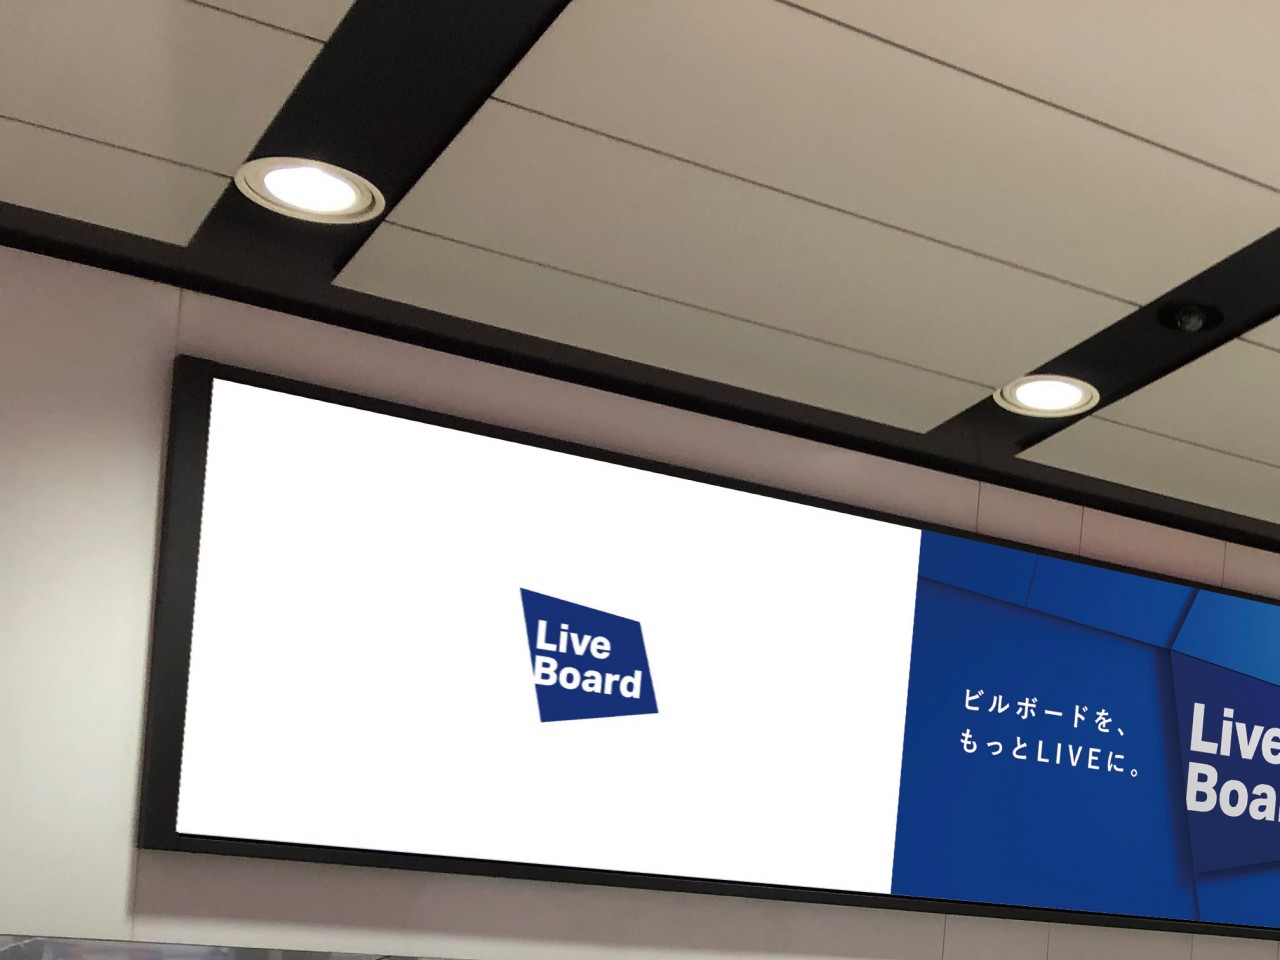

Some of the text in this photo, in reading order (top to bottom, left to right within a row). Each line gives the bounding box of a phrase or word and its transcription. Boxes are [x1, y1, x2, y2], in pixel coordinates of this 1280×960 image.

[536, 619, 611, 660] Live
[534, 655, 643, 700] Board
[963, 688, 1125, 737] ビルボードを、
[959, 728, 1139, 779] もっとLIVEに。
